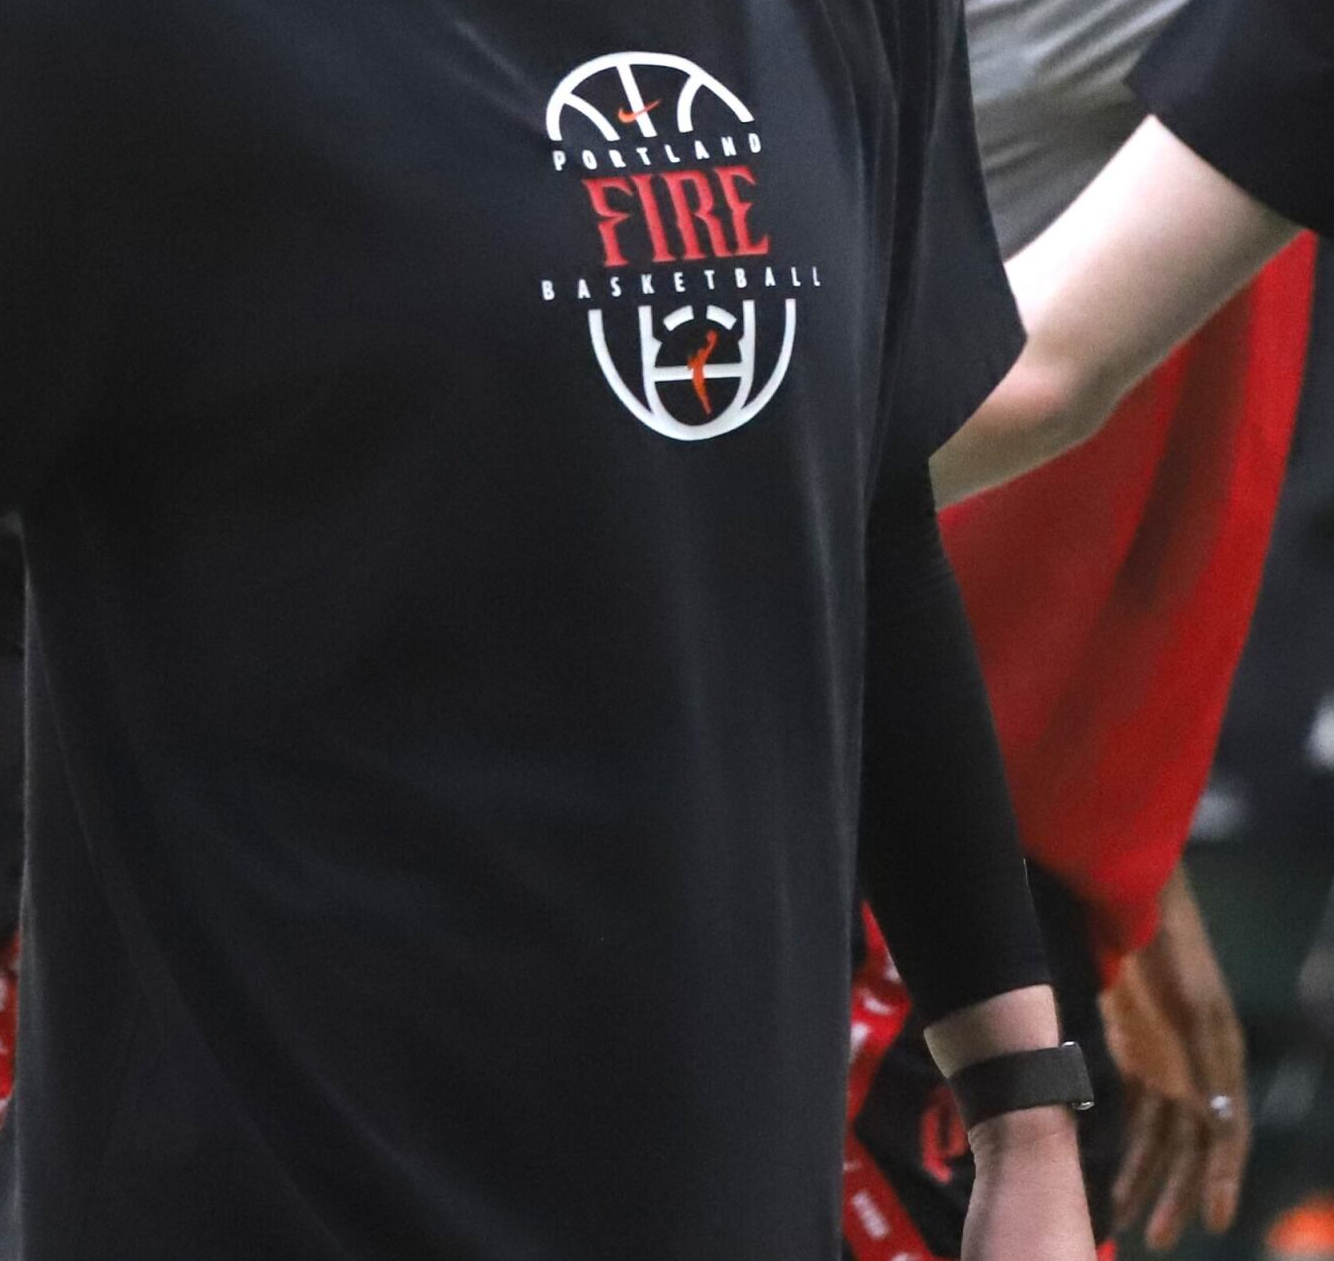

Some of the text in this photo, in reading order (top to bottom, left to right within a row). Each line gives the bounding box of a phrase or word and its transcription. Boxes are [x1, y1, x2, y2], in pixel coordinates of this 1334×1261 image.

[552, 133, 763, 171] PORTLAND
[582, 165, 771, 267] FIRE
[541, 266, 821, 301] BASKETBALL
